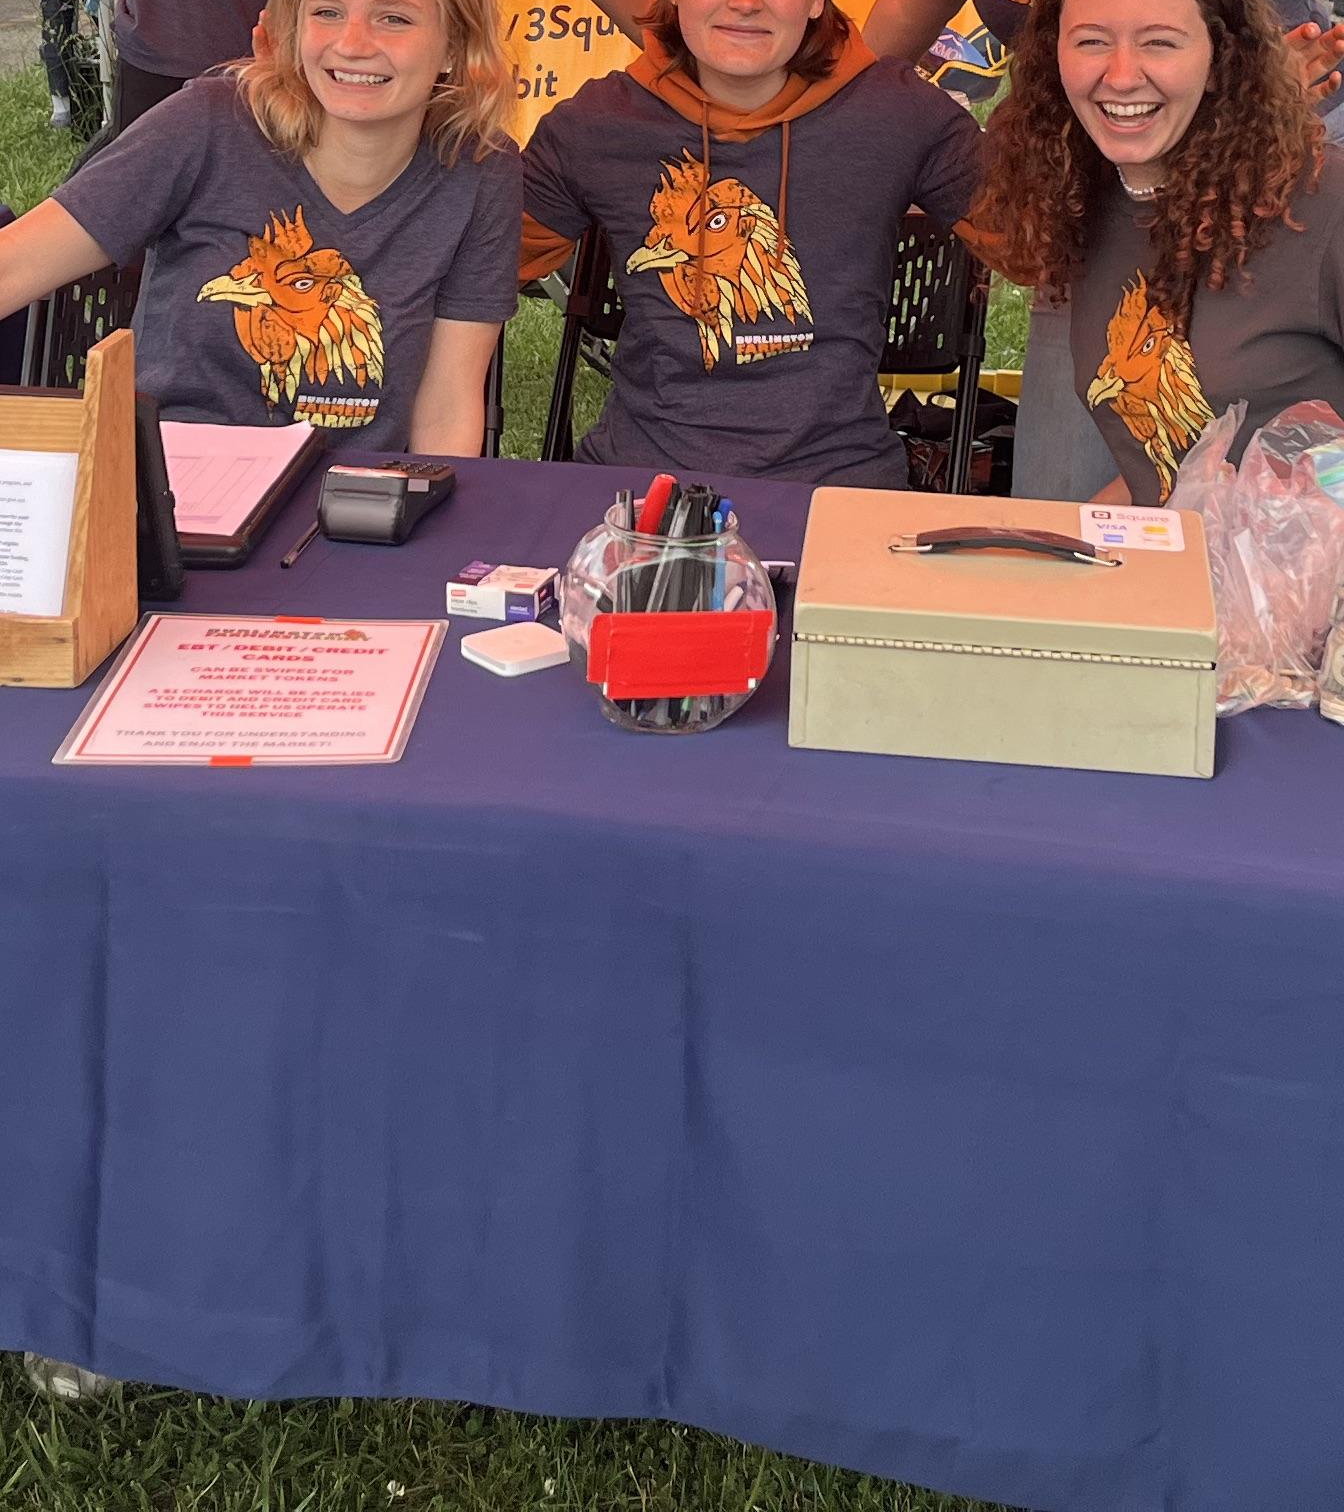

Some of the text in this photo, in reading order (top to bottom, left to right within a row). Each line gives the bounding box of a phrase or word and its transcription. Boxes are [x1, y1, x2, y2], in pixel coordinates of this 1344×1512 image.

[524, 4, 626, 52] 3Squ
[735, 332, 814, 345] BURLINGTON
[297, 394, 380, 407] BURLINGTON
[296, 401, 377, 417] FARMERS
[293, 410, 375, 428] MARKET
[1116, 512, 1170, 522] Square
[1096, 523, 1128, 531] VISA
[176, 643, 221, 651] EBT
[234, 644, 296, 653] DEBIT
[311, 645, 390, 655] CREDIT
[241, 654, 315, 662] CARDS
[253, 667, 319, 675] SWIPED
[275, 675, 339, 683] TOKENS
[200, 710, 235, 718] THIS
[115, 729, 168, 737] THANK
[171, 729, 203, 737] YOU
[238, 730, 367, 738] UNDERSTANDING
[177, 740, 228, 748] ENJOY
[231, 740, 260, 748] THE
